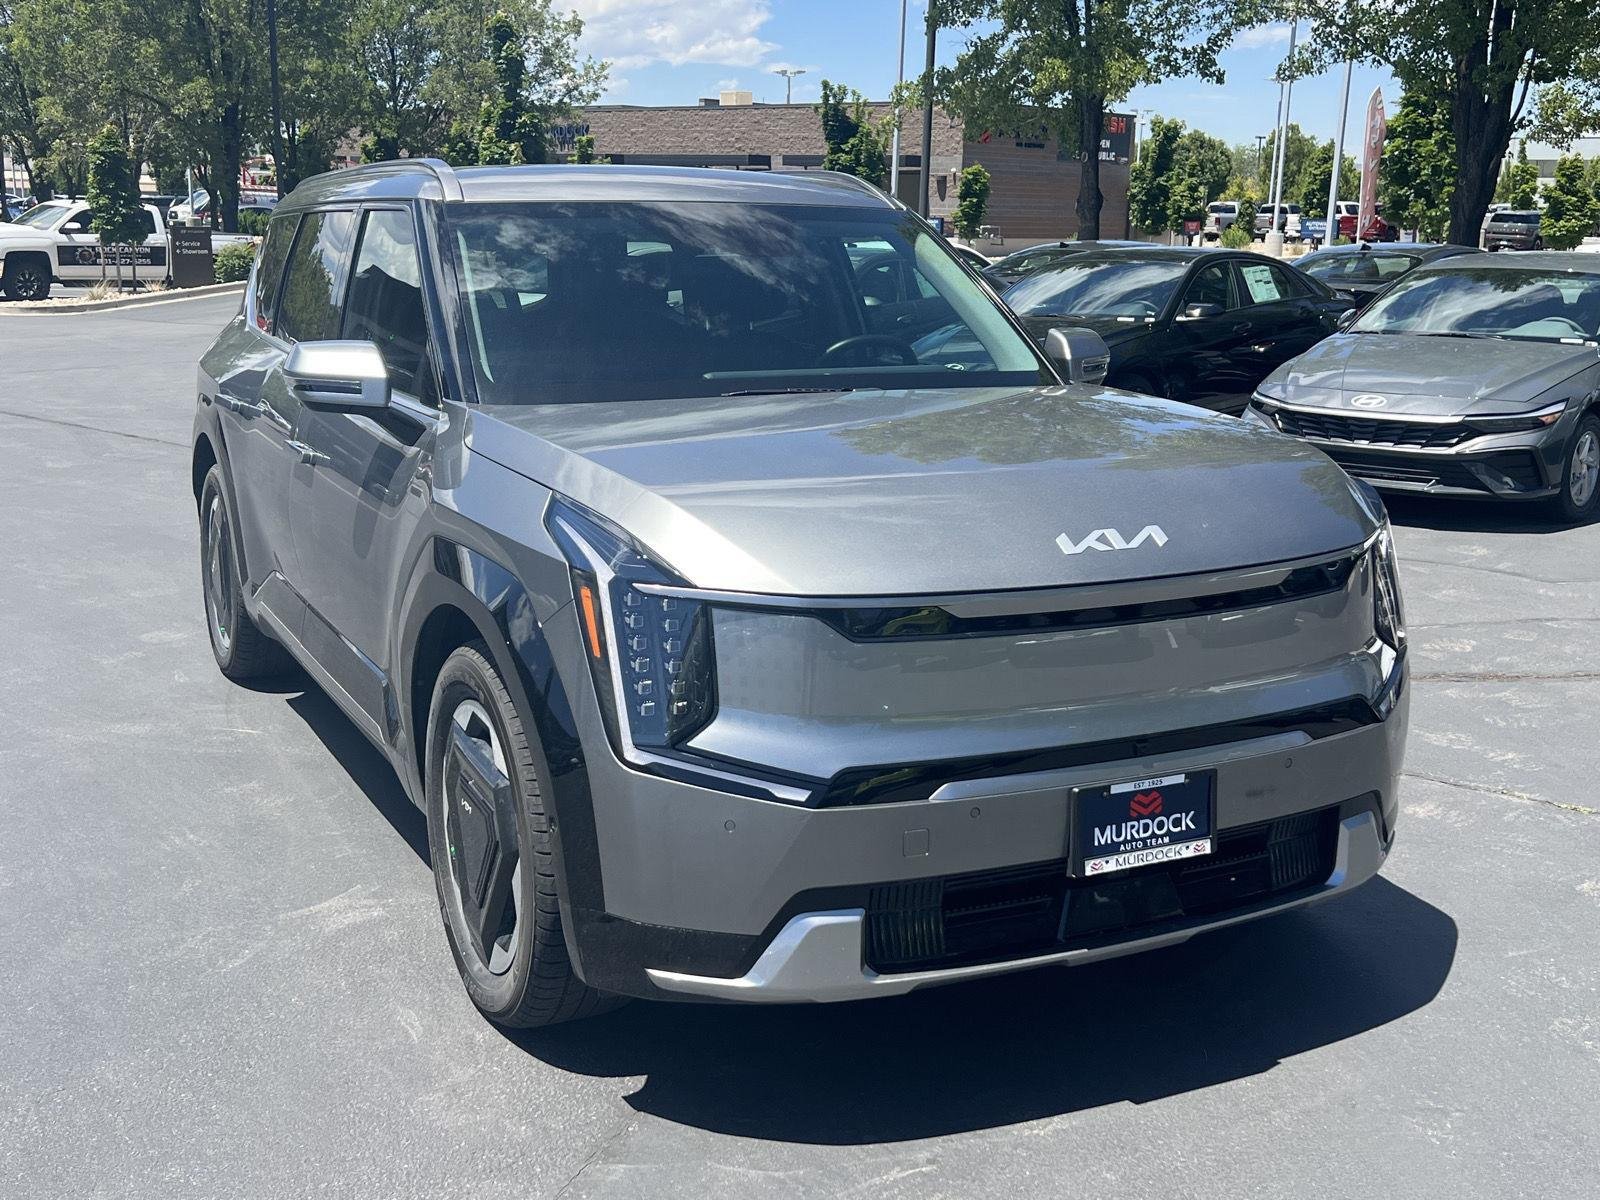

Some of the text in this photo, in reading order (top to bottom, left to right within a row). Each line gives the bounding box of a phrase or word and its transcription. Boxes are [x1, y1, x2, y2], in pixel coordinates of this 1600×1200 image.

[1098, 151, 1116, 161] UBLIC
[1148, 778, 1164, 788] 1925
[1093, 810, 1196, 847] MURDOCK
[1119, 836, 1170, 852] AUTO TEAM
[1114, 845, 1183, 868] MURDOCK
